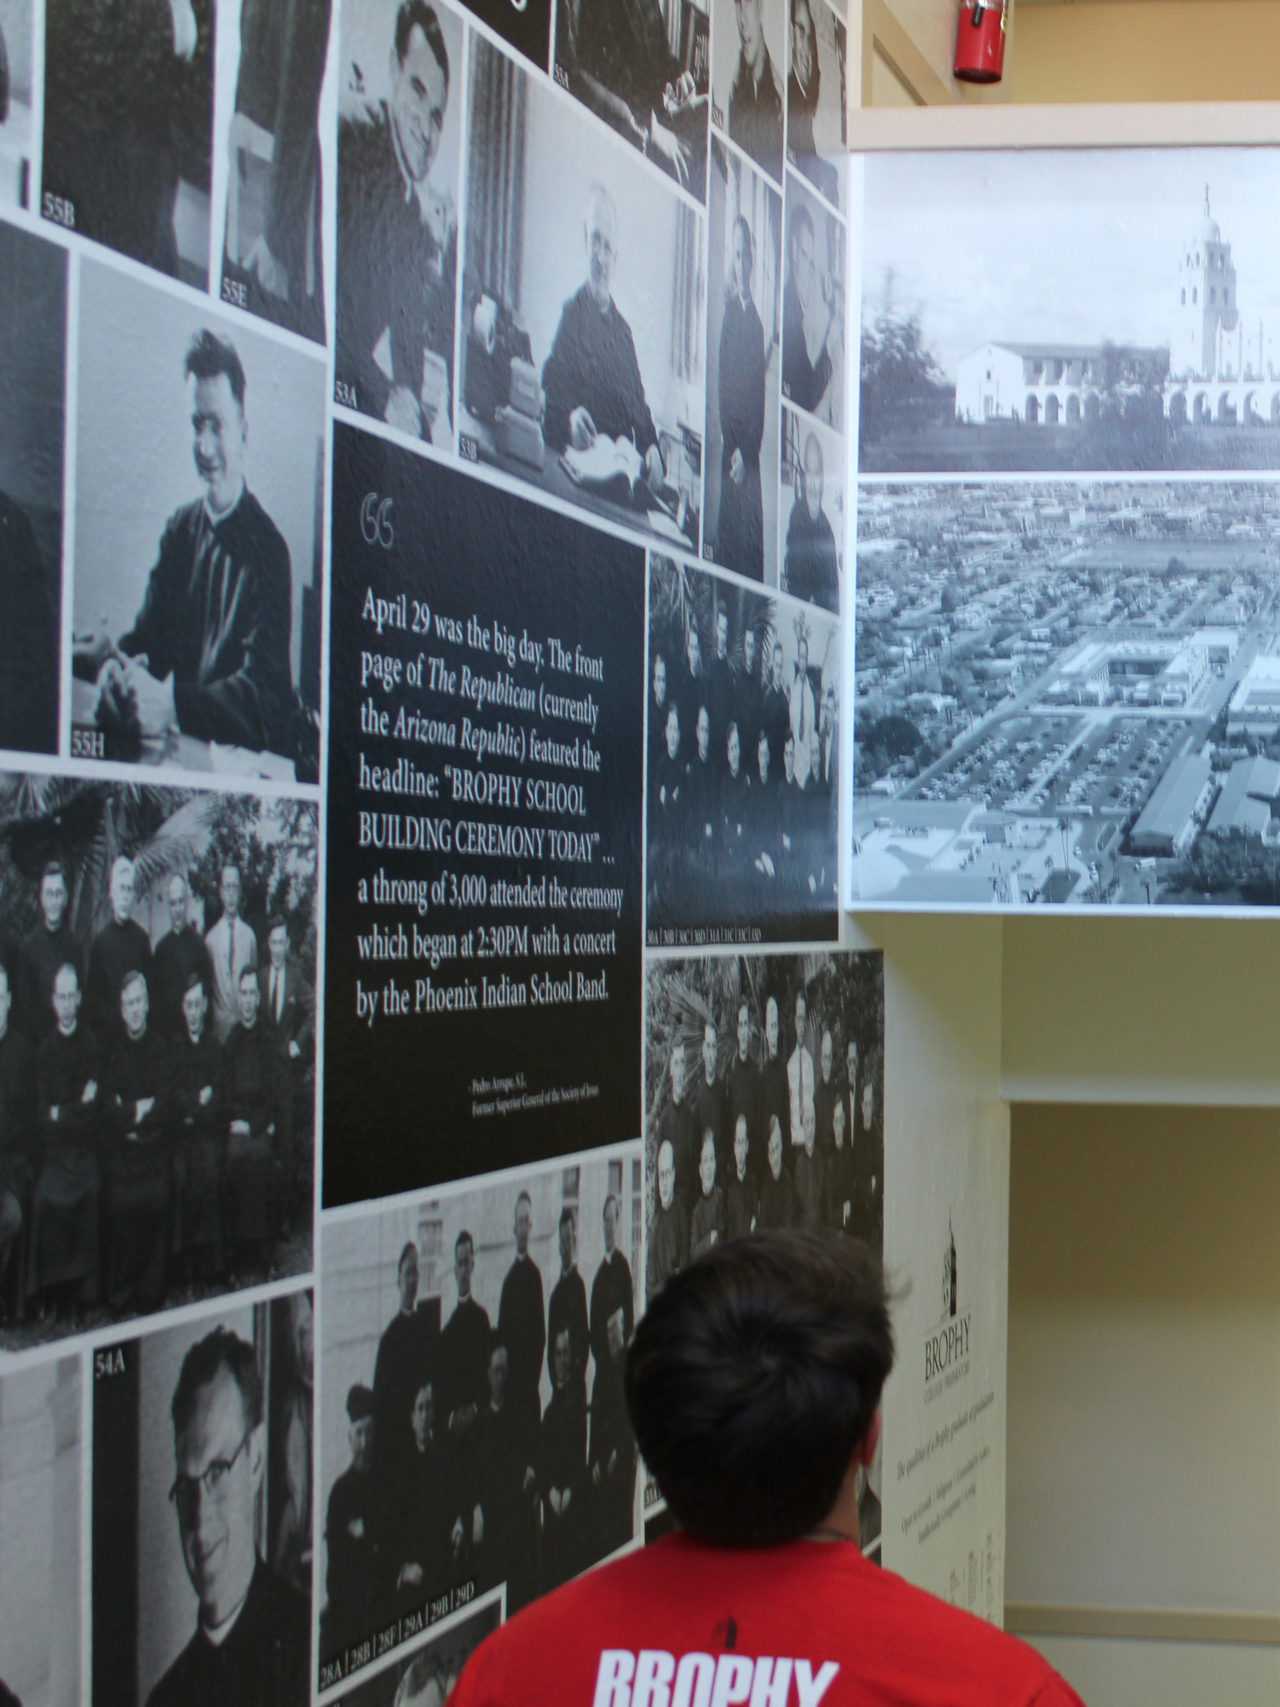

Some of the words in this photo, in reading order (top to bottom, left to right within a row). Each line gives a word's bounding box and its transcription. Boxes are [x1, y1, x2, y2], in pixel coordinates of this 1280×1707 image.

[44, 191, 75, 228] 55B
[362, 587, 406, 634] April
[412, 601, 430, 635] 29
[435, 613, 463, 644] was
[467, 614, 490, 650] the
[494, 620, 516, 667] big
[519, 629, 545, 673] day.
[547, 637, 573, 671] The
[575, 644, 604, 682] front
[361, 651, 401, 692] page
[406, 653, 424, 685] of
[429, 657, 455, 694] The
[460, 664, 536, 712] Republican
[539, 682, 600, 734] (currently
[72, 730, 104, 758] 55H
[361, 697, 389, 735] the
[393, 705, 455, 746] Arizona
[460, 717, 527, 763] Republic)
[529, 728, 579, 769] featured
[582, 741, 601, 772] the
[359, 752, 440, 798] headline:
[526, 775, 586, 817] SCHOOL
[359, 811, 451, 852] BUILDING
[455, 821, 548, 863] CEREMONY
[358, 877, 368, 904] a
[373, 867, 428, 916] throng
[431, 870, 449, 905] of
[450, 875, 487, 909] 3,000
[490, 875, 546, 909] attended
[549, 876, 567, 910] the
[569, 886, 624, 917] ceremony
[358, 923, 409, 961] which
[412, 923, 458, 970] began
[460, 926, 475, 957] at
[477, 925, 529, 957] 2:30PM
[531, 924, 559, 956] with
[562, 932, 571, 955] a
[573, 929, 616, 955] concert
[356, 980, 379, 1028] by
[383, 978, 410, 1016] the
[415, 977, 478, 1014] Phoenix
[482, 973, 527, 1008] Indian
[530, 971, 573, 1005] School
[576, 969, 609, 1000] Band.
[924, 1316, 971, 1381] BROPHY
[593, 1649, 840, 1707] BROPHY
